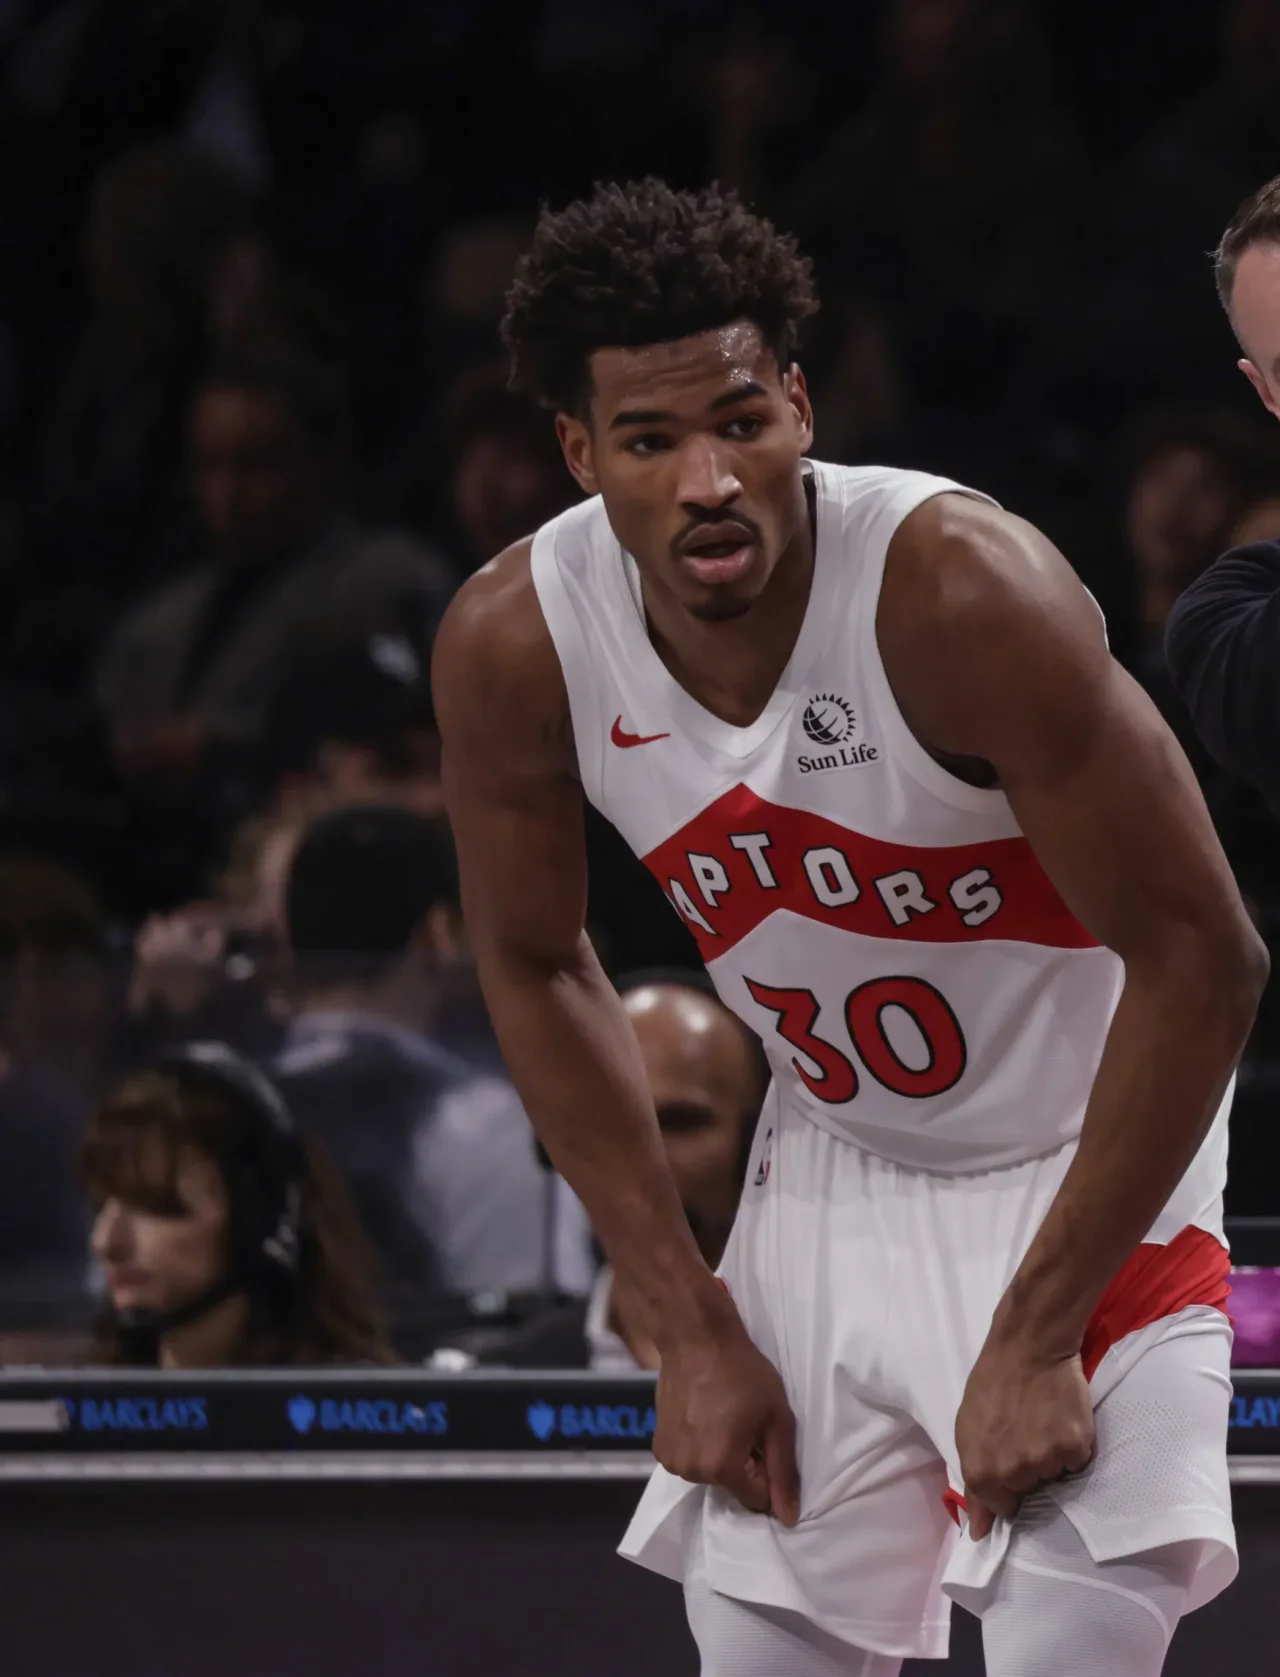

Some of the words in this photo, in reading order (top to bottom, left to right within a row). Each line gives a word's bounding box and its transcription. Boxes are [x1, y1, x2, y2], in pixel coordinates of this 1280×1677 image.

[797, 755, 839, 774] Sun
[838, 743, 879, 766] Life
[663, 830, 1003, 938] APTORS
[742, 975, 967, 1104] 30
[80, 1397, 209, 1430] BARCLAYS
[320, 1398, 448, 1434] BARCLAYS
